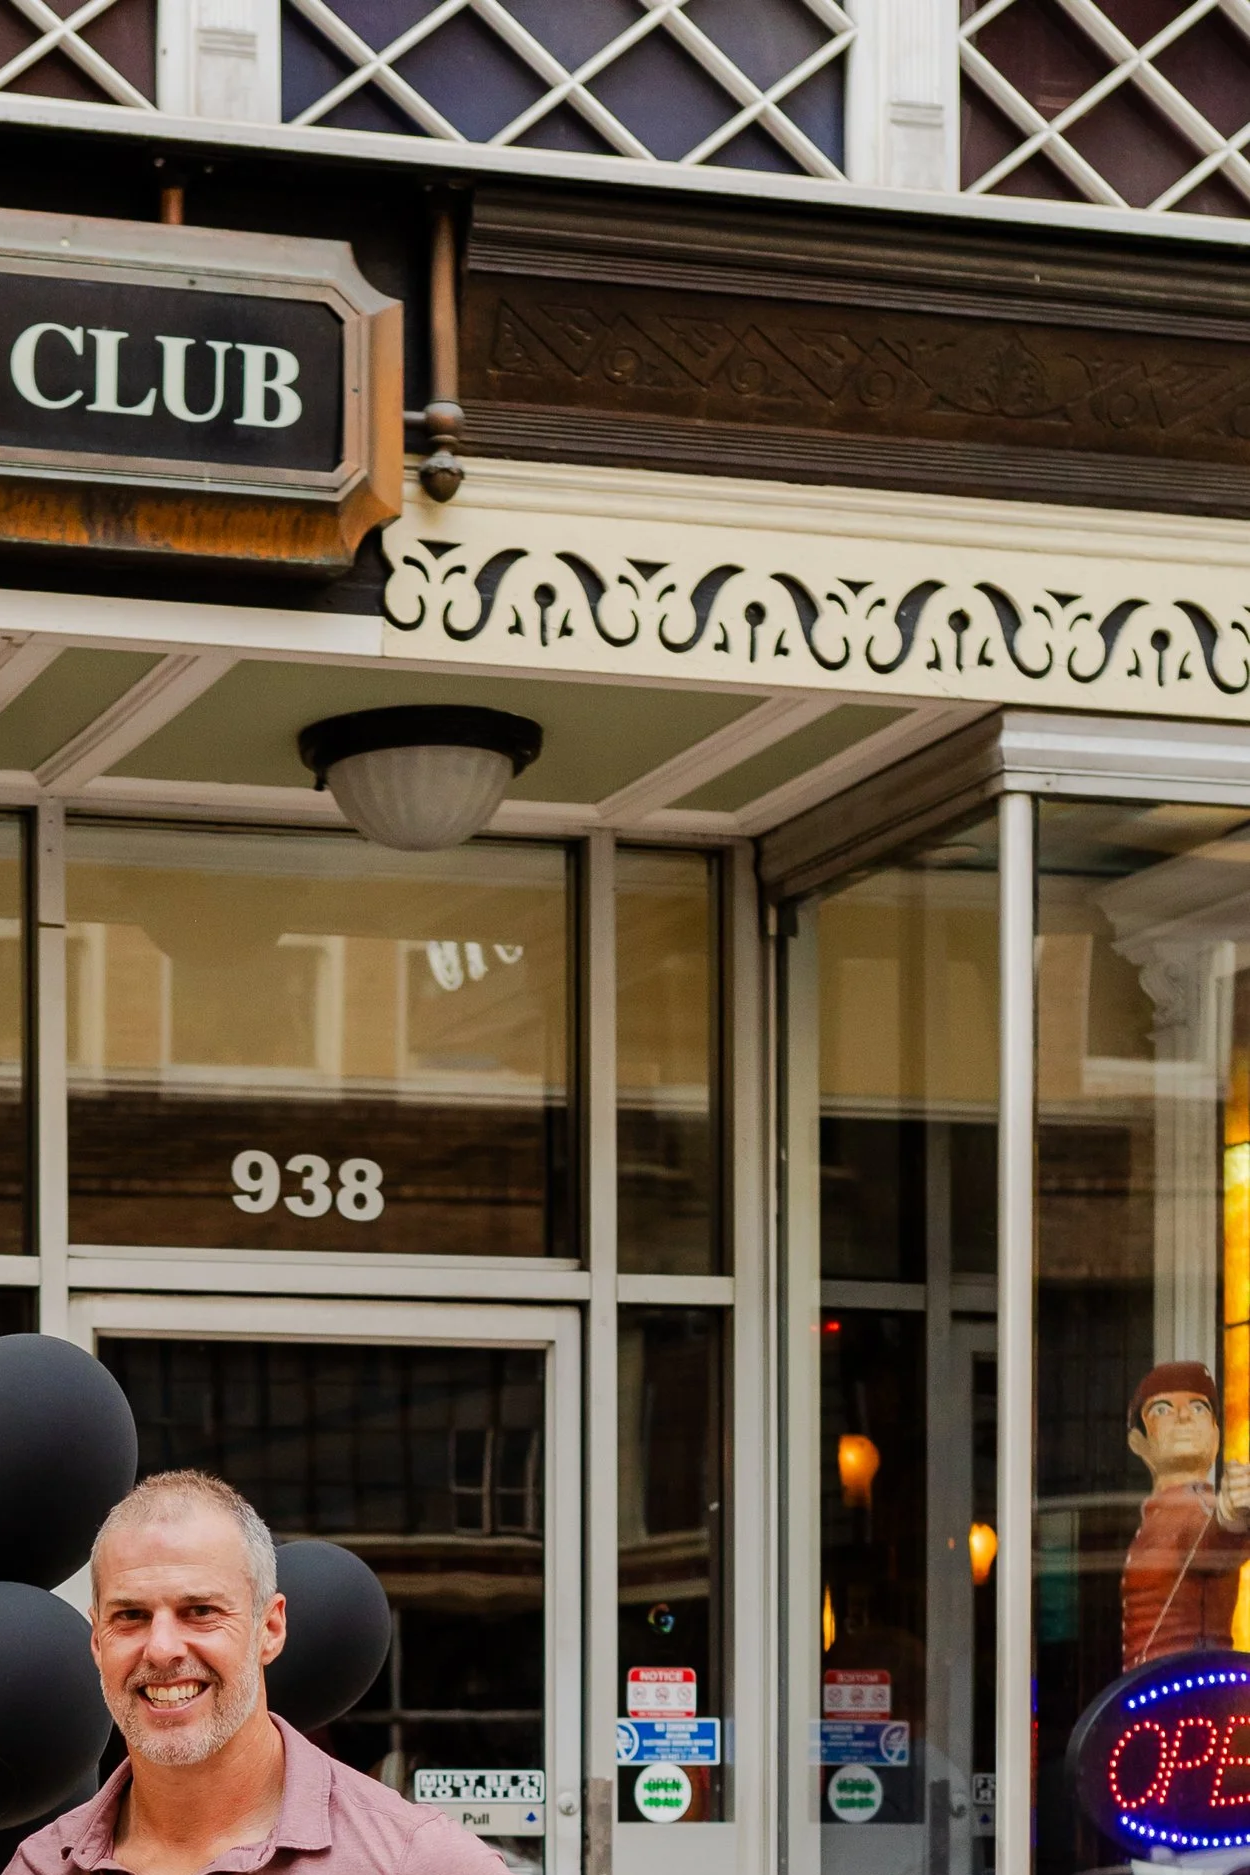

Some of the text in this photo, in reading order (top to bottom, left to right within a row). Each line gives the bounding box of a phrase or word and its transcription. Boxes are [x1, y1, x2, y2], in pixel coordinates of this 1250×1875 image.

[9, 322, 303, 429] CLUB
[231, 1150, 385, 1222] 938
[639, 1671, 684, 1682] NOTICE
[421, 1774, 476, 1788] MUST
[485, 1774, 511, 1788] BE
[421, 1785, 540, 1798] TO ENTER
[463, 1812, 490, 1825] Pull
